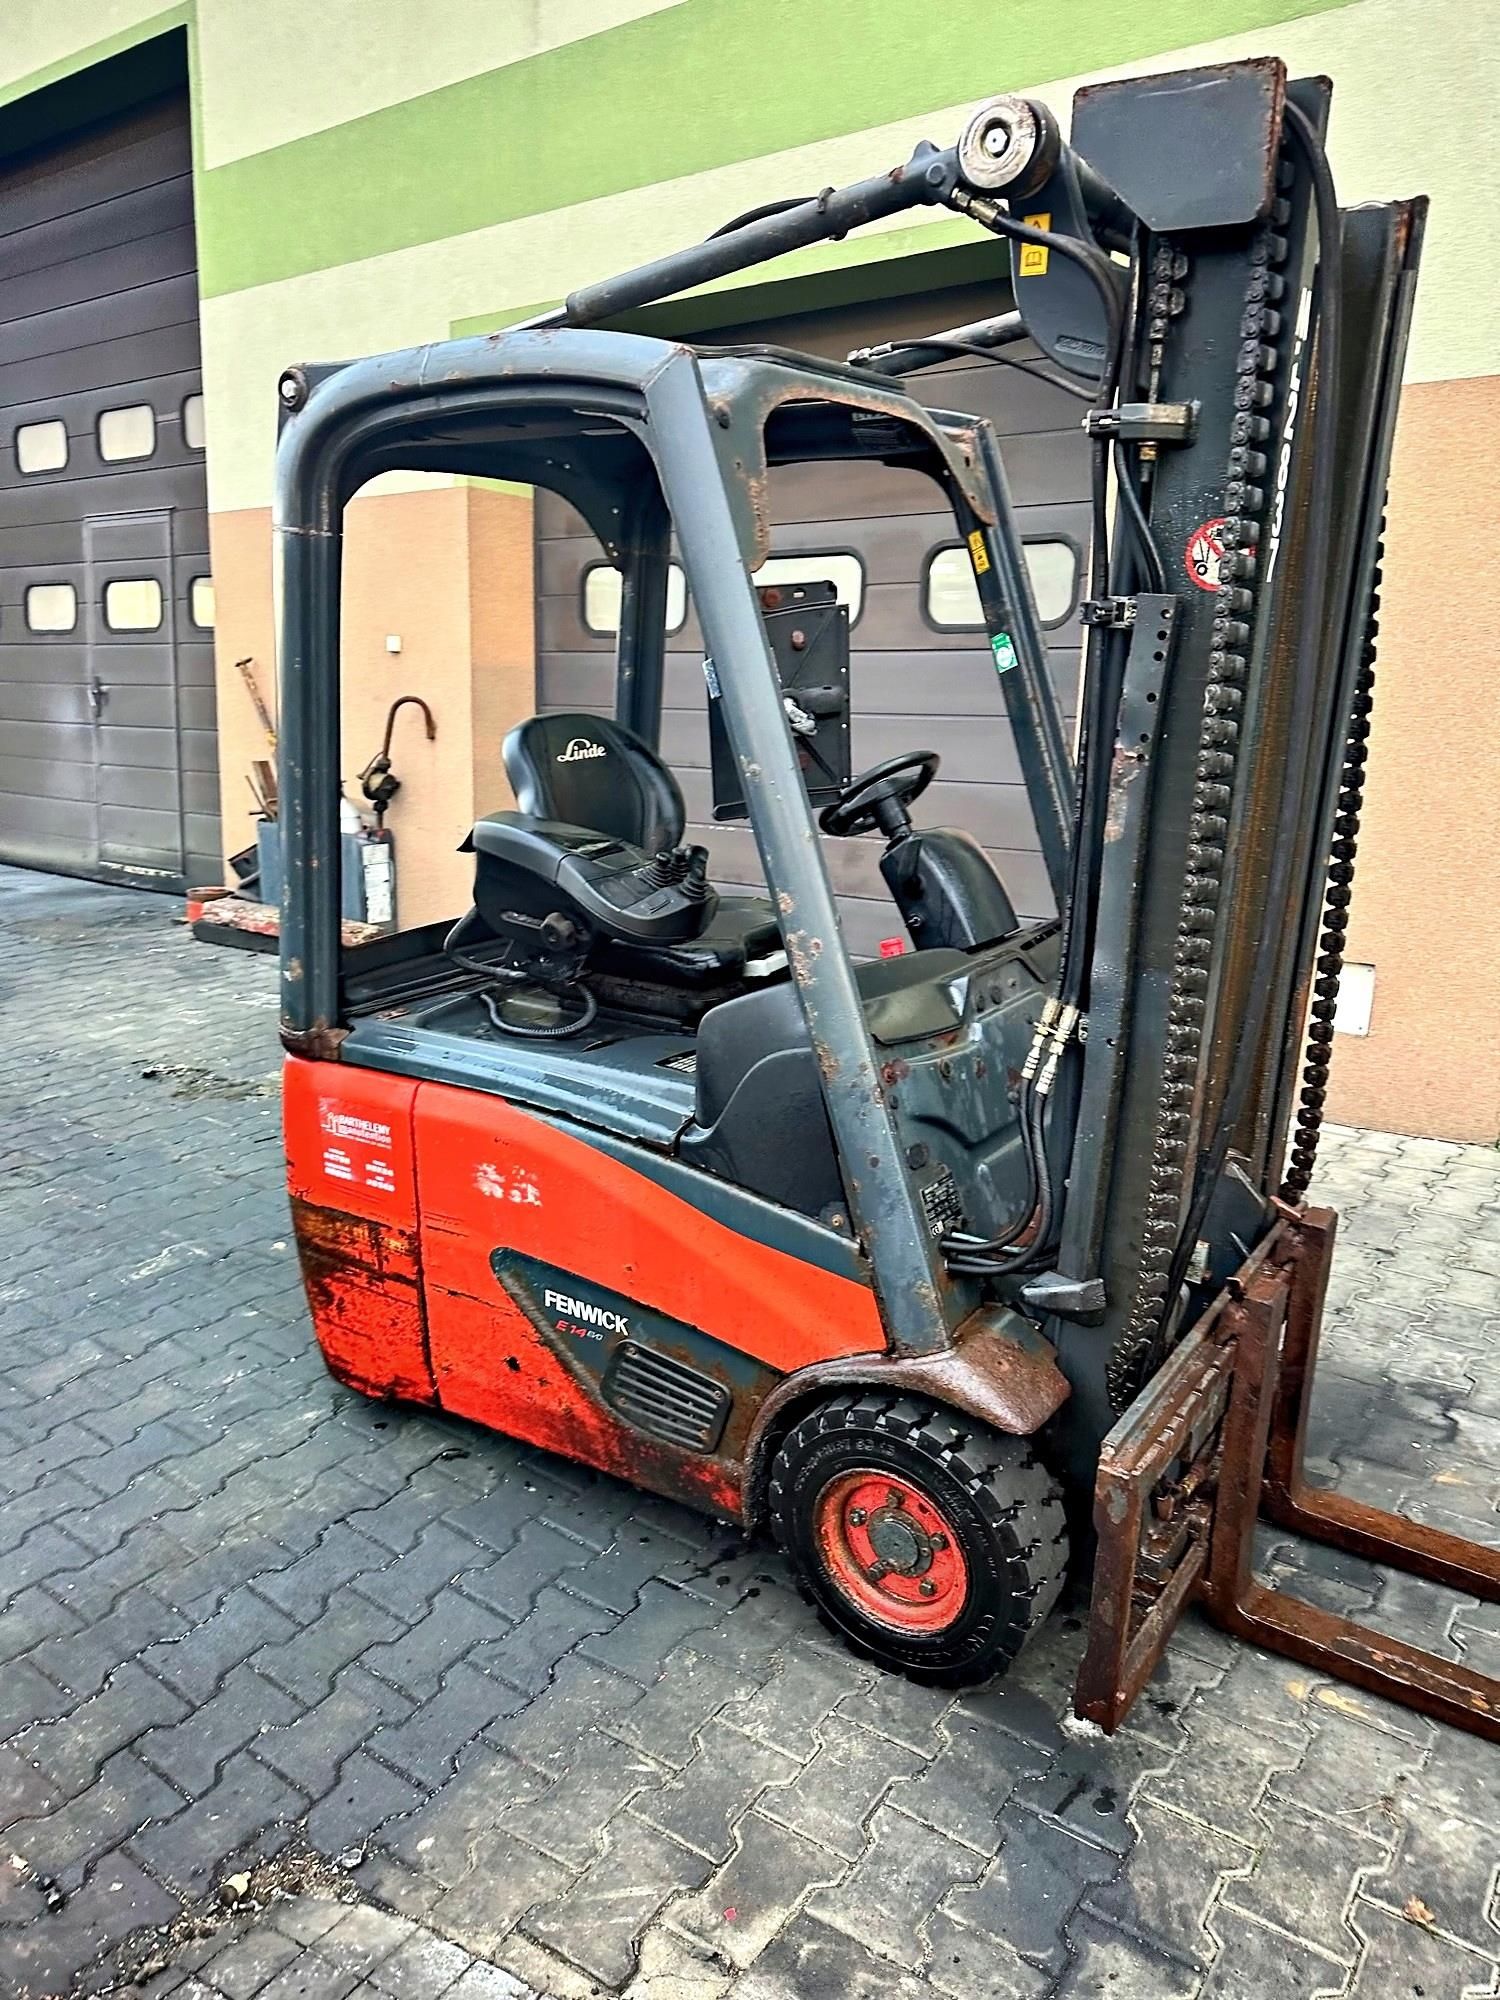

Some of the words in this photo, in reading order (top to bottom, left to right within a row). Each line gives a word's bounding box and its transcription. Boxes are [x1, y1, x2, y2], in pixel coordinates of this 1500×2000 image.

[556, 738, 607, 762] Linde
[337, 1114, 391, 1136] BARTHELEMY
[545, 1289, 629, 1336] FENWICK
